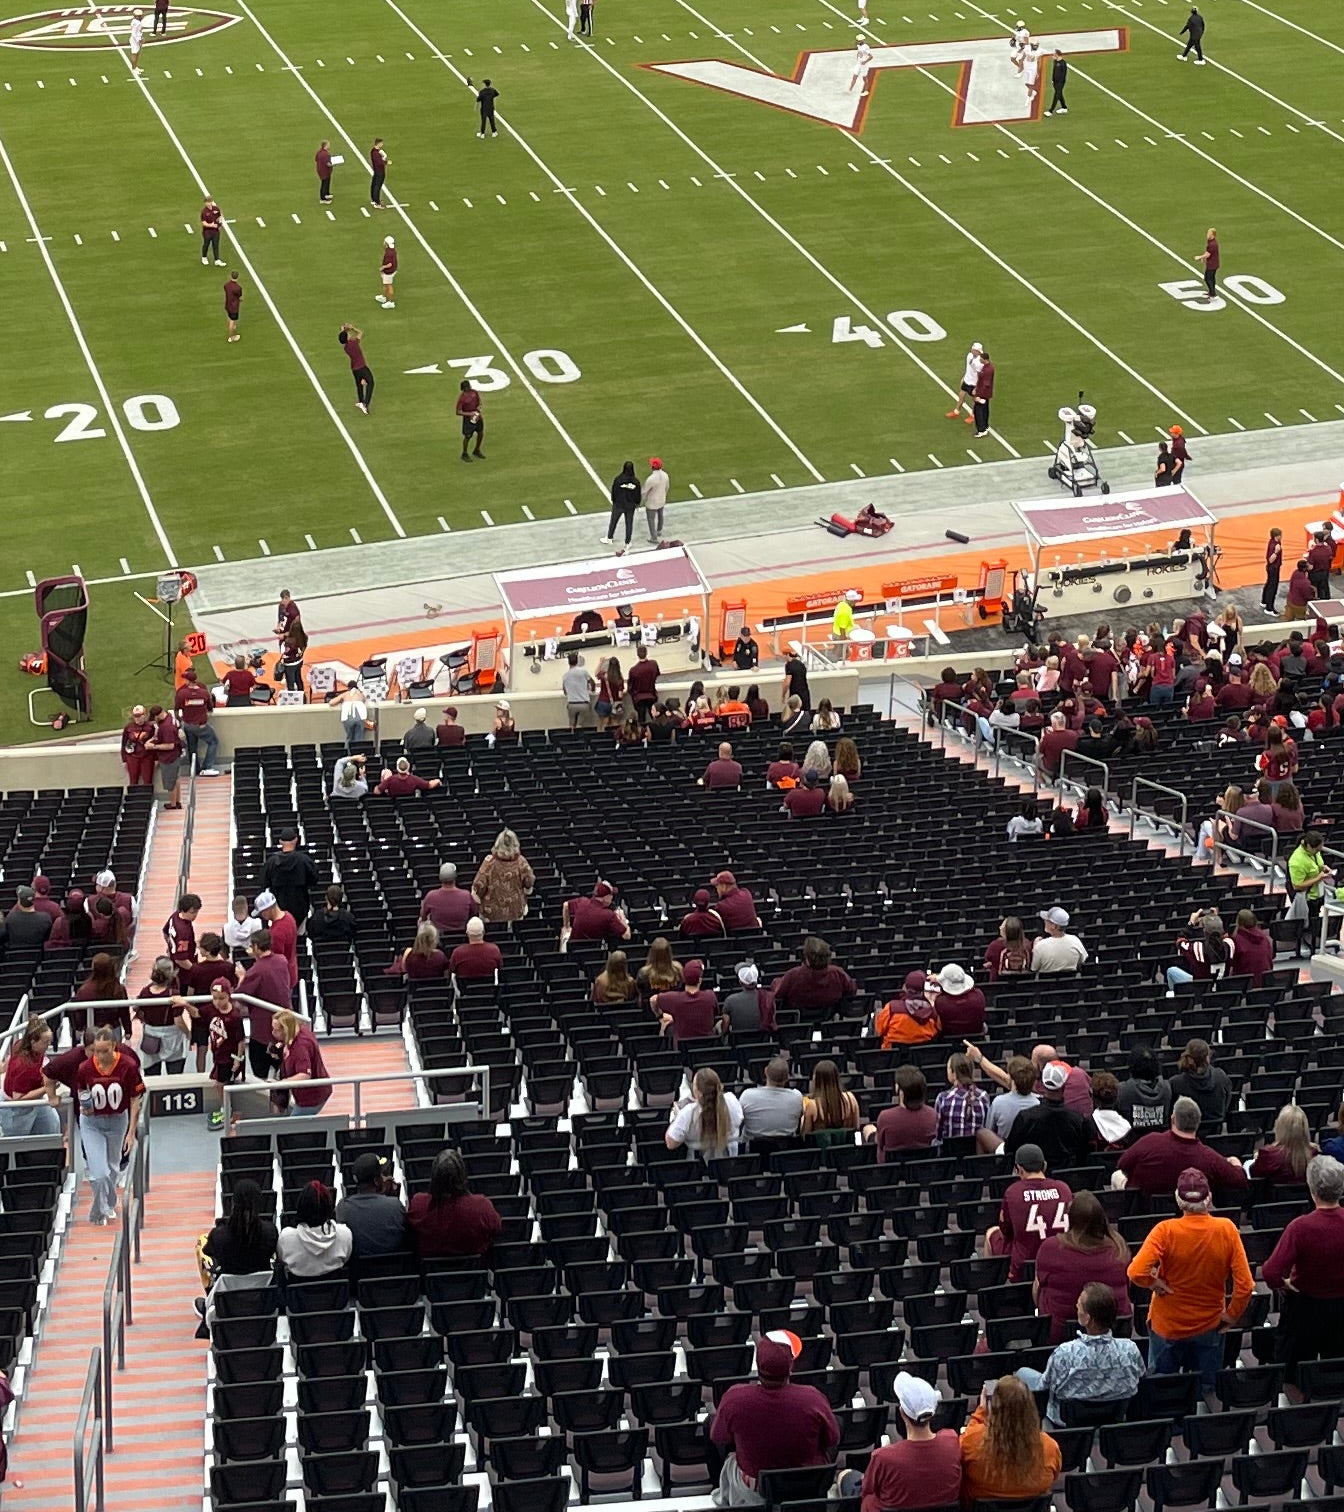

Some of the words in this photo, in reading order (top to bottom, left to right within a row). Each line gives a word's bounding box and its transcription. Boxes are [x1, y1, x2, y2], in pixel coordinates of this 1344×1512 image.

[632, 26, 1132, 135] VT
[1157, 274, 1288, 314] 50
[830, 309, 949, 349] 40
[446, 349, 584, 396] 30
[42, 393, 182, 444] 20
[900, 580, 943, 594] GATORADE
[806, 595, 846, 609] GATORA
[188, 634, 207, 655] 20
[858, 646, 869, 658] G
[91, 1083, 123, 1111] 00
[161, 1092, 197, 1111] 113
[1023, 1188, 1060, 1202] STRONG
[1025, 1201, 1070, 1240] 44
